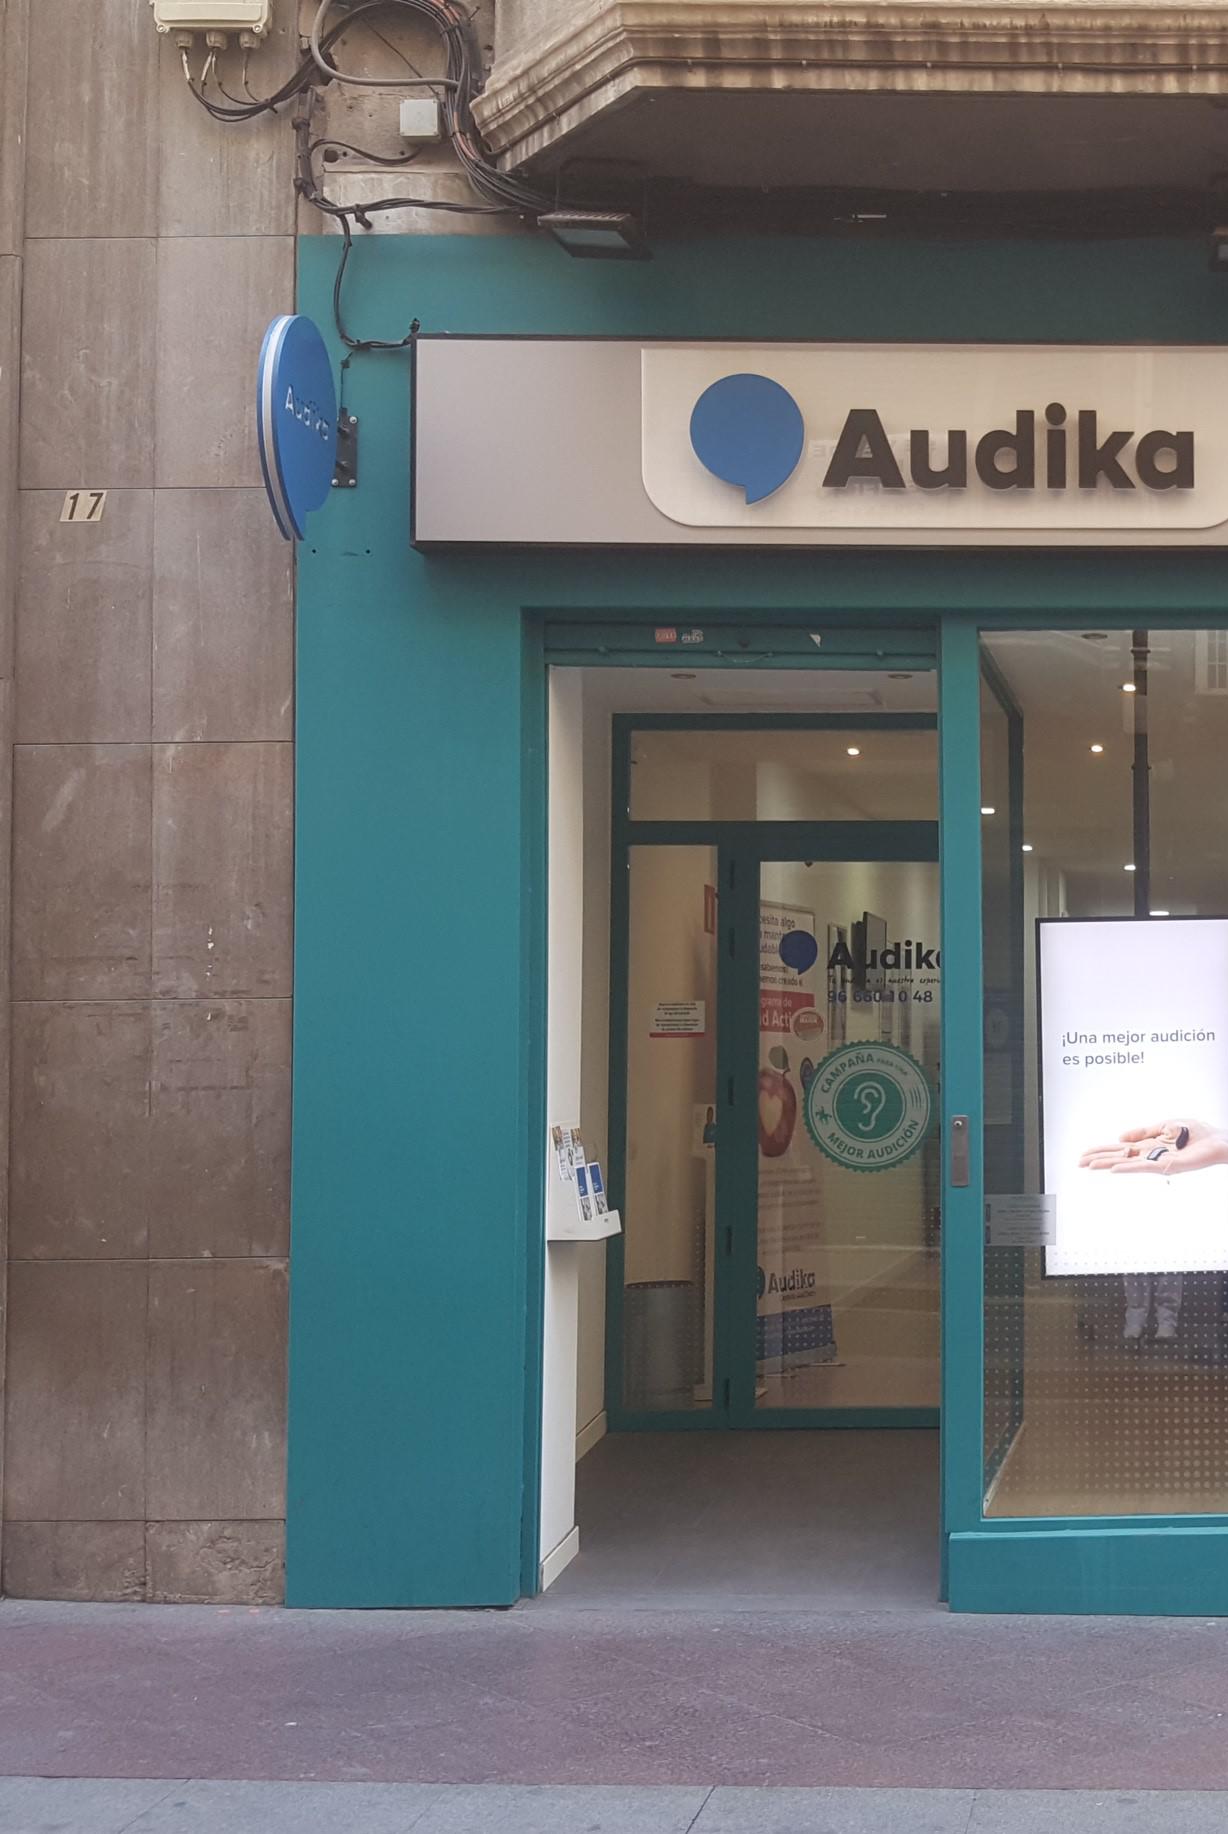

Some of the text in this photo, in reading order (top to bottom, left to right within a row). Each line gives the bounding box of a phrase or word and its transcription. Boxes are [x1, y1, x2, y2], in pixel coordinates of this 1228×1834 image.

[822, 402, 1195, 490] Audika
[68, 492, 104, 520] 17
[913, 990, 933, 1003] 48
[1062, 1028, 1215, 1047] ¡Una mejor audición
[821, 1053, 874, 1093] CAMPAÑA
[1062, 1052, 1145, 1068] es posible!
[827, 1119, 919, 1159] MEJOR AUDICIÓN
[768, 1268, 815, 1295] Audika
